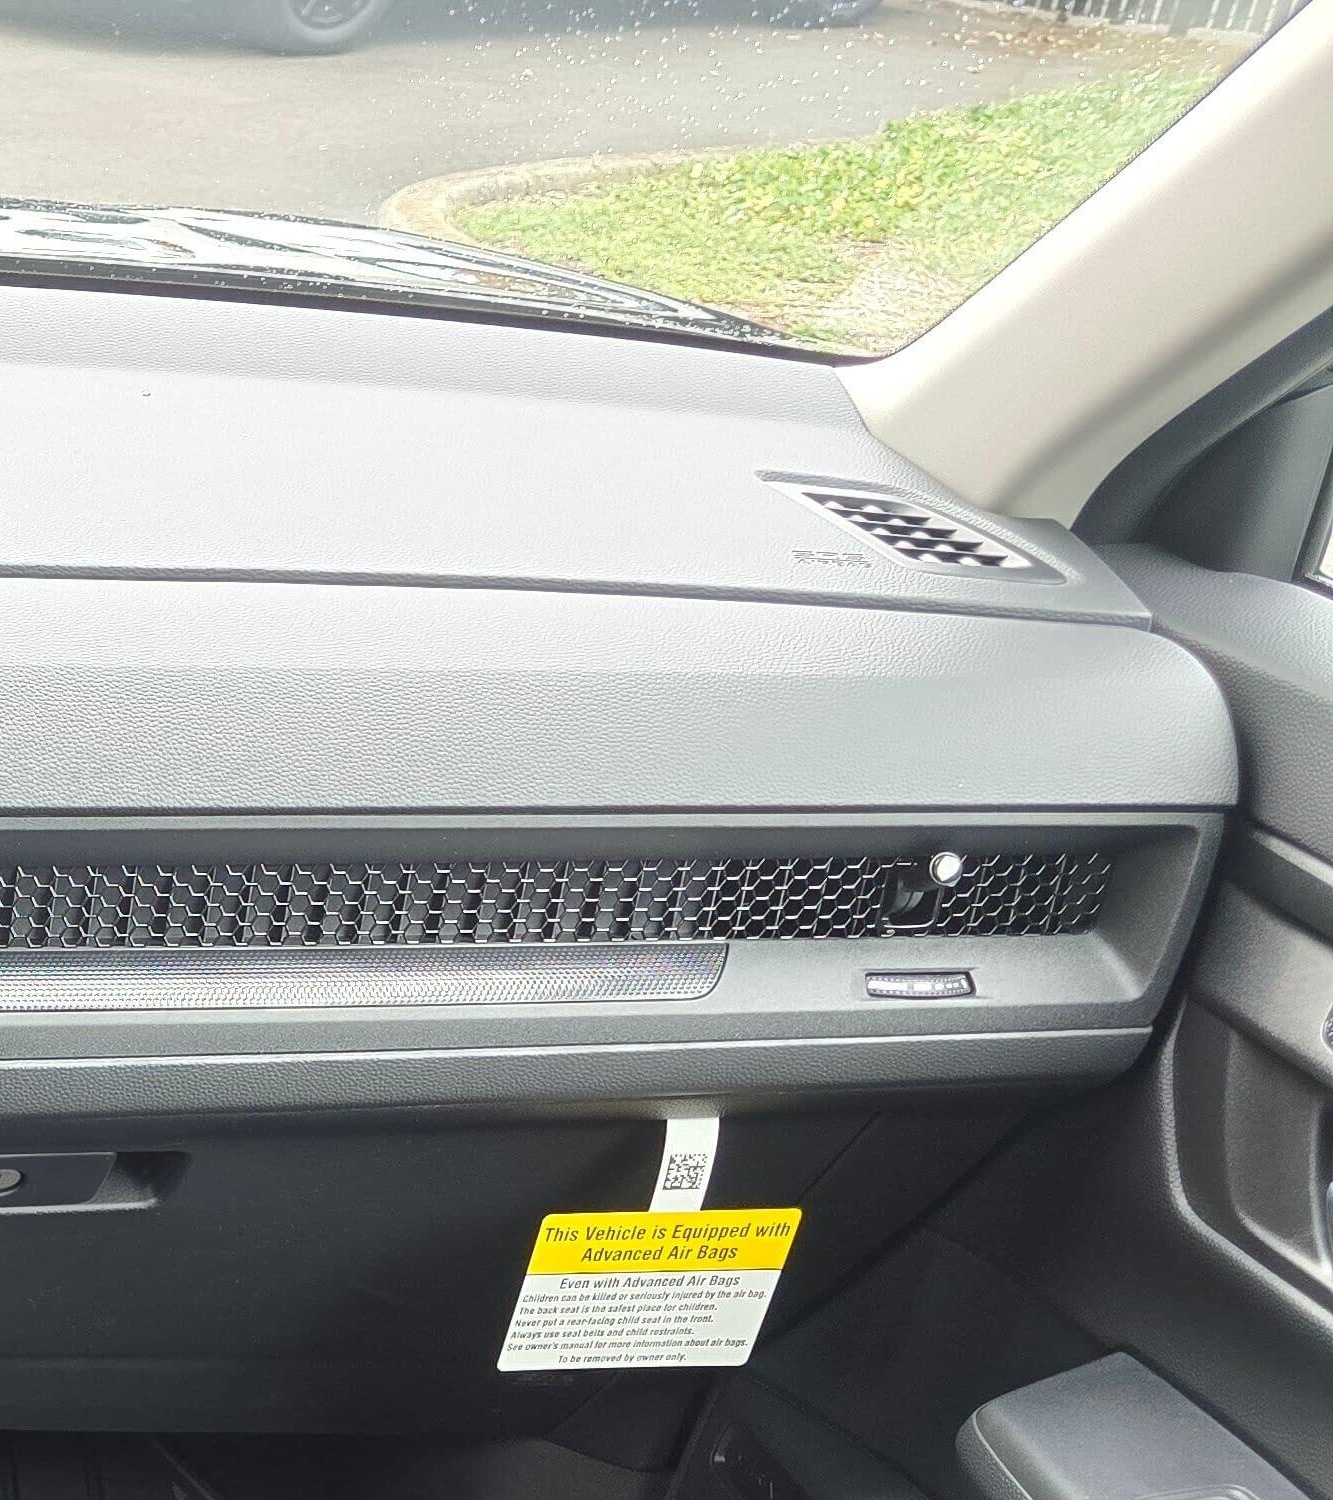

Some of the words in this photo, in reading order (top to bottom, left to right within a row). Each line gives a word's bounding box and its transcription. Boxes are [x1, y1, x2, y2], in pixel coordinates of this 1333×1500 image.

[544, 1227, 579, 1243] This
[585, 1226, 646, 1241] Vehicle
[652, 1225, 666, 1240] is
[671, 1223, 751, 1243] Equipped
[755, 1222, 791, 1238] with
[580, 1246, 662, 1263] Advanced
[667, 1245, 693, 1261] Air
[696, 1244, 738, 1262] Bags
[559, 1277, 589, 1290] Even
[593, 1276, 620, 1289] with
[624, 1275, 684, 1288] Advanced
[687, 1275, 707, 1287] Air
[708, 1274, 741, 1288] Bags
[522, 1294, 559, 1303] Children
[579, 1293, 590, 1302] be
[592, 1292, 617, 1301] killed
[629, 1291, 670, 1301] seriously
[671, 1290, 703, 1300] injured
[705, 1290, 716, 1300] by
[717, 1290, 731, 1299] the
[733, 1290, 746, 1299] air
[748, 1289, 766, 1300] bag.
[519, 1306, 535, 1315] The
[537, 1306, 558, 1315] back
[560, 1305, 580, 1314] seat
[592, 1304, 606, 1313] the
[607, 1304, 636, 1313] safest
[636, 1303, 661, 1314] place
[663, 1303, 677, 1312] for
[678, 1302, 718, 1311] children.
[514, 1319, 541, 1328] Never
[542, 1318, 558, 1328] put
[566, 1316, 616, 1327] rear-facing
[617, 1315, 640, 1325] child
[641, 1315, 661, 1324] seat
[674, 1315, 688, 1324] the
[690, 1314, 714, 1323] front.
[511, 1330, 542, 1340] Always
[562, 1329, 581, 1338] seat
[583, 1329, 605, 1338] belts
[607, 1328, 624, 1337] and
[625, 1327, 648, 1337] child
[649, 1326, 695, 1336] restraints.
[506, 1342, 523, 1351] See
[525, 1341, 558, 1351] owner's
[560, 1340, 593, 1350] manual
[594, 1340, 607, 1349] for
[608, 1341, 631, 1349] more
[632, 1338, 682, 1348] information
[684, 1338, 710, 1347] about
[710, 1338, 723, 1347] air
[724, 1338, 748, 1348] bags.
[570, 1354, 581, 1363] be
[583, 1353, 623, 1363] removed
[624, 1353, 635, 1363] by
[636, 1353, 664, 1362] owner
[665, 1352, 687, 1362] only.
